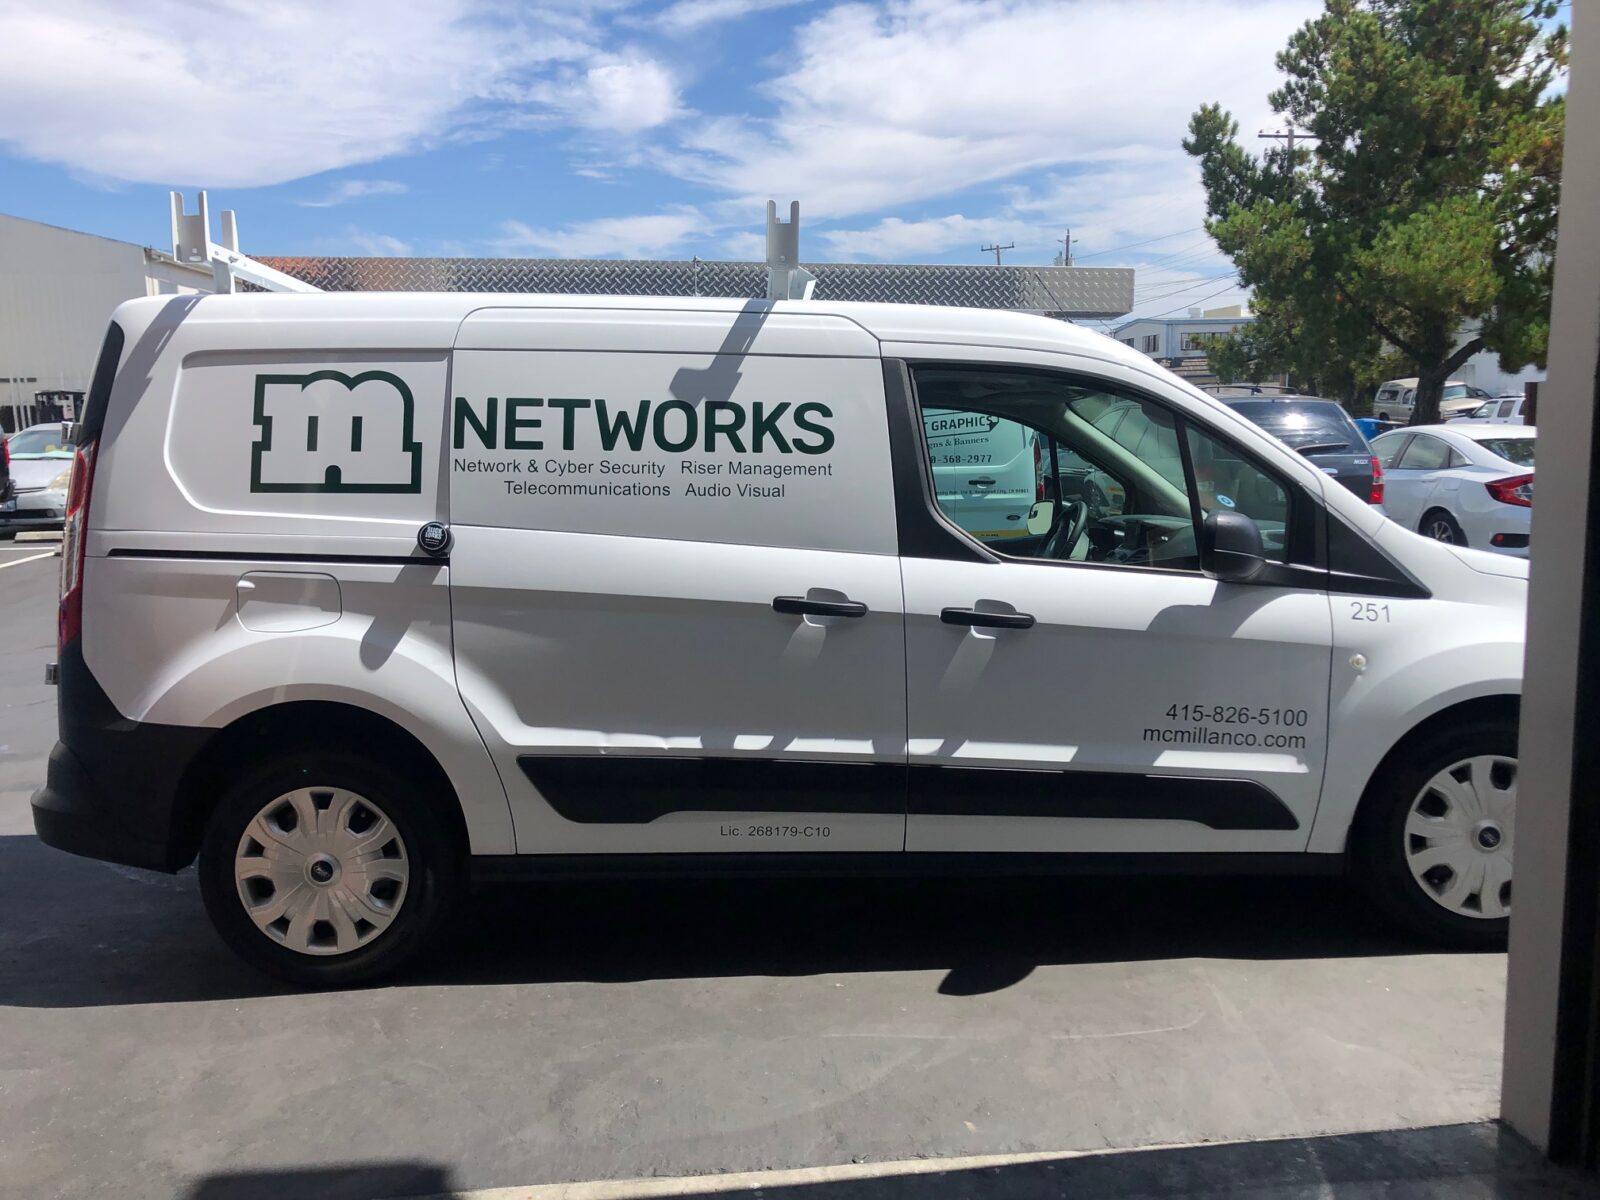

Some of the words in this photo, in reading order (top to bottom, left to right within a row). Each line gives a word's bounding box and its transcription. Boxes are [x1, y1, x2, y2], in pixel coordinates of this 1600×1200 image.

[453, 397, 835, 455] NETWORKS
[931, 415, 992, 431] GRAPHICS
[954, 437, 989, 446] Banners
[454, 458, 521, 473] Network
[527, 459, 539, 473] &
[545, 459, 594, 476] Cyber
[600, 460, 665, 478] Security
[681, 460, 723, 475] Riser
[728, 461, 833, 479] Management
[504, 480, 671, 497] Telecommunications
[685, 482, 732, 497] Audio
[736, 483, 785, 498] Visual
[1351, 601, 1391, 623] 251
[1166, 703, 1308, 727] 415-826-5100
[1143, 727, 1306, 748] mcmillanco.com
[720, 825, 743, 837] Lic.
[748, 825, 831, 838] 268179-C10
